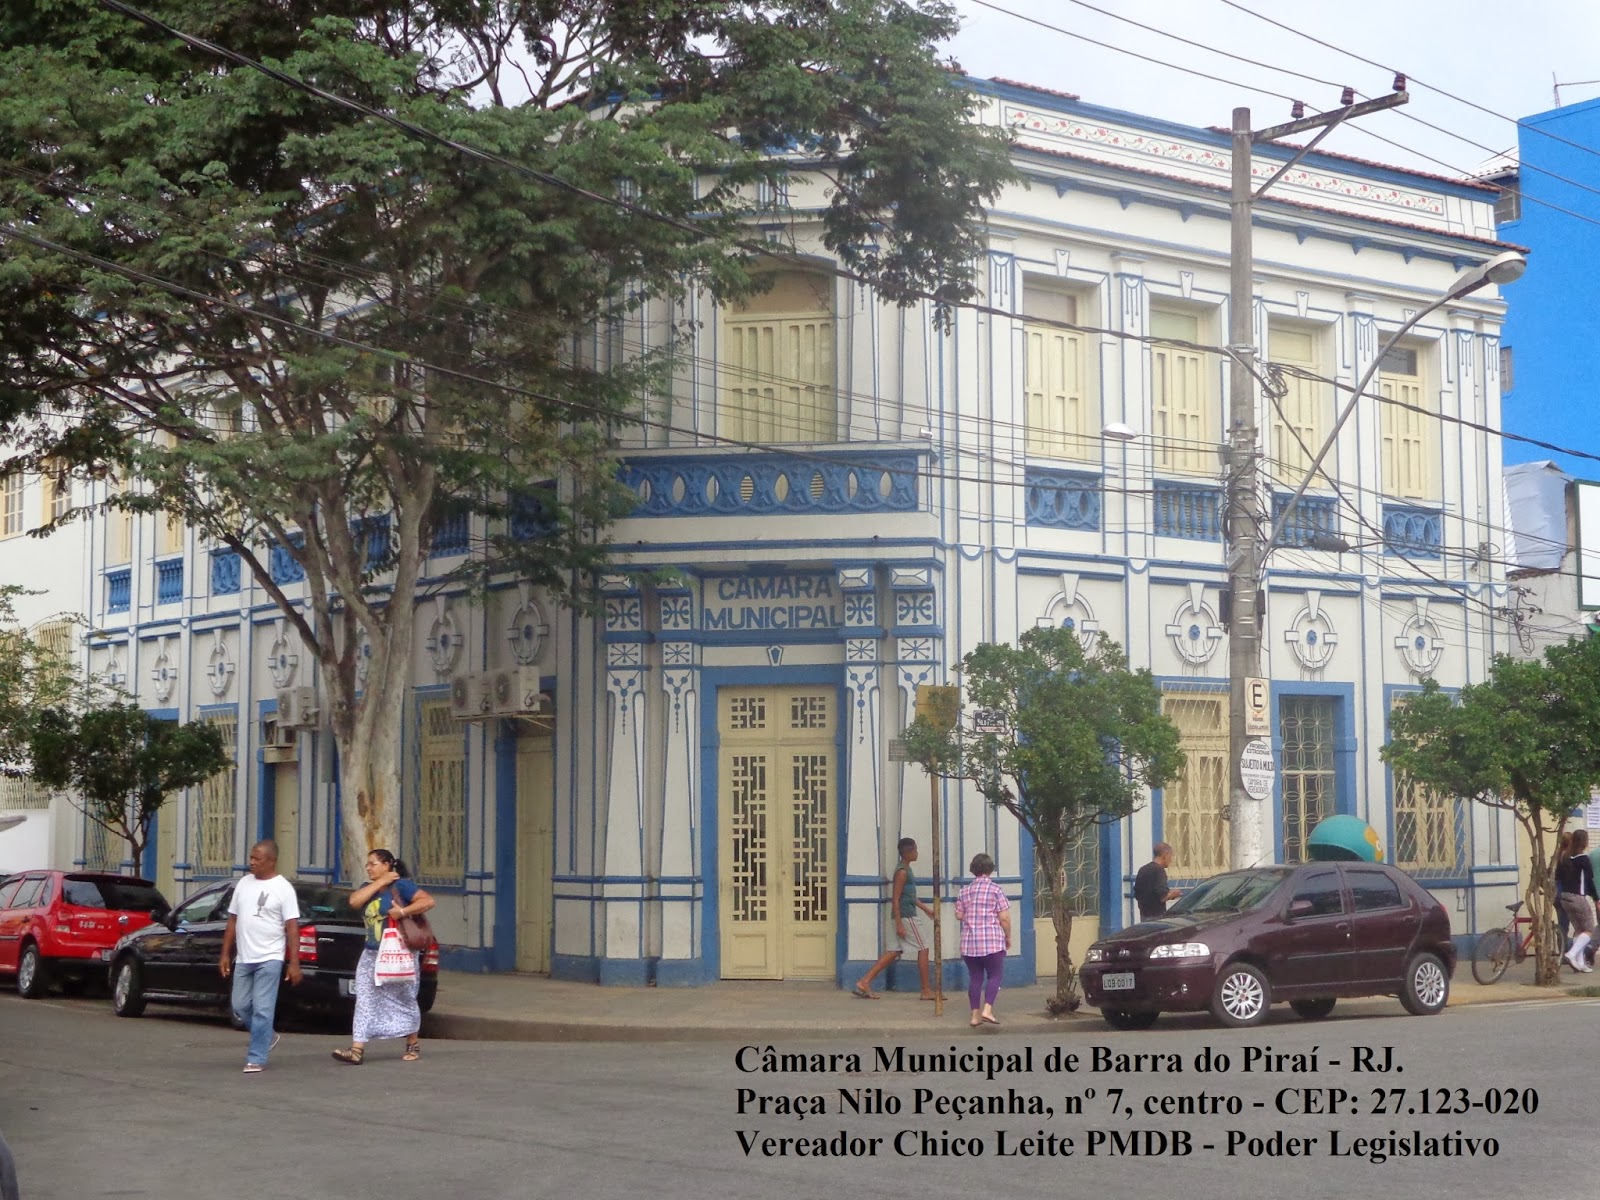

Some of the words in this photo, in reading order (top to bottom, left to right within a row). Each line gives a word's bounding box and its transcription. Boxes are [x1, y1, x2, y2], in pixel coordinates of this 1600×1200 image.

[704, 605, 844, 630] MUNICIPAL
[1252, 683, 1263, 708] E
[1241, 758, 1259, 770] SUJEITO
